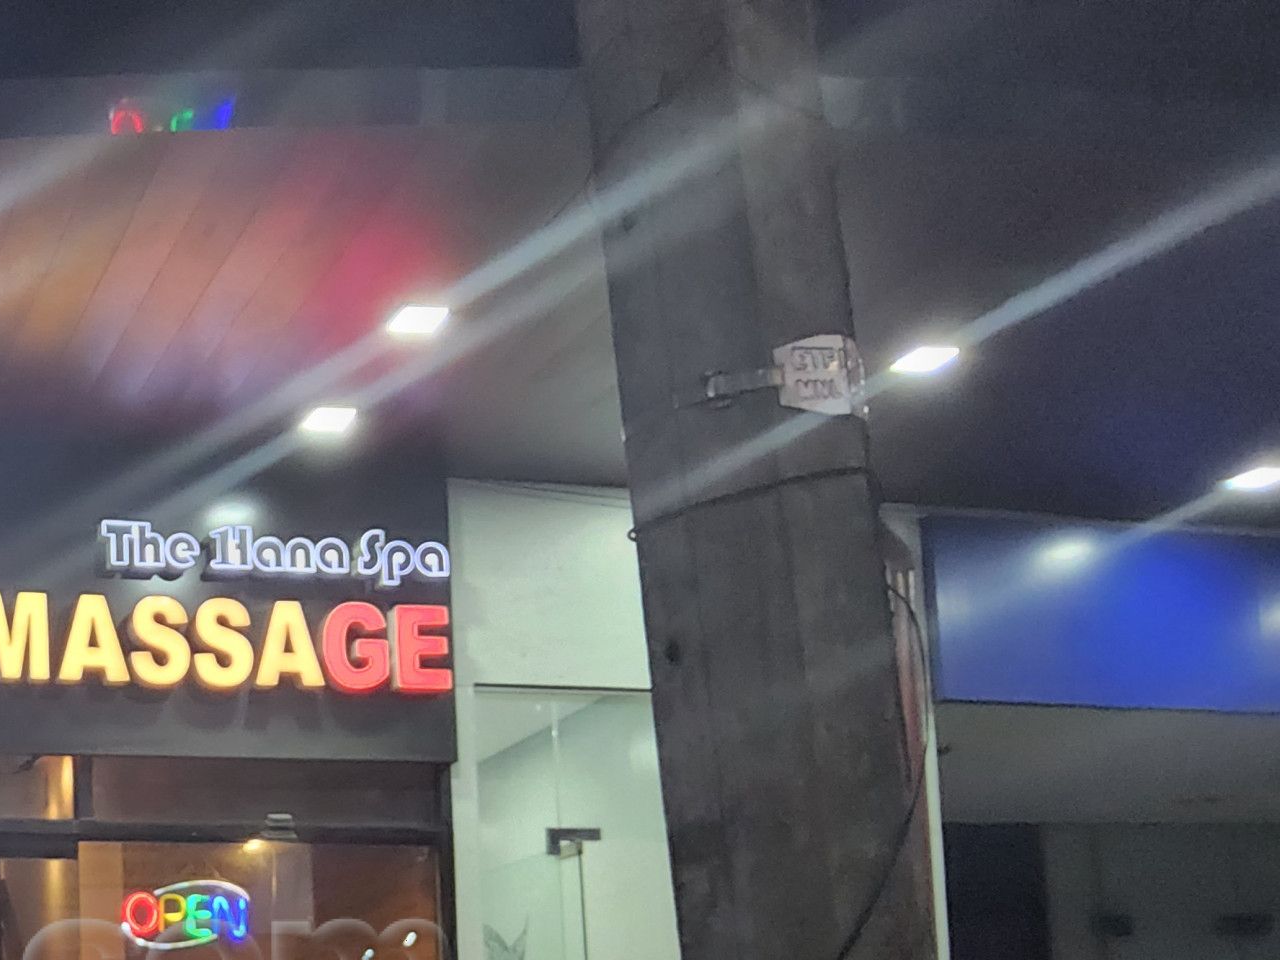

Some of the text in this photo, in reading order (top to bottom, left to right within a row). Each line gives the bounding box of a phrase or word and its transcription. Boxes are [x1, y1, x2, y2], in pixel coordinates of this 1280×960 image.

[100, 519, 451, 587] The Hana Spa
[122, 890, 249, 942] OPEN
